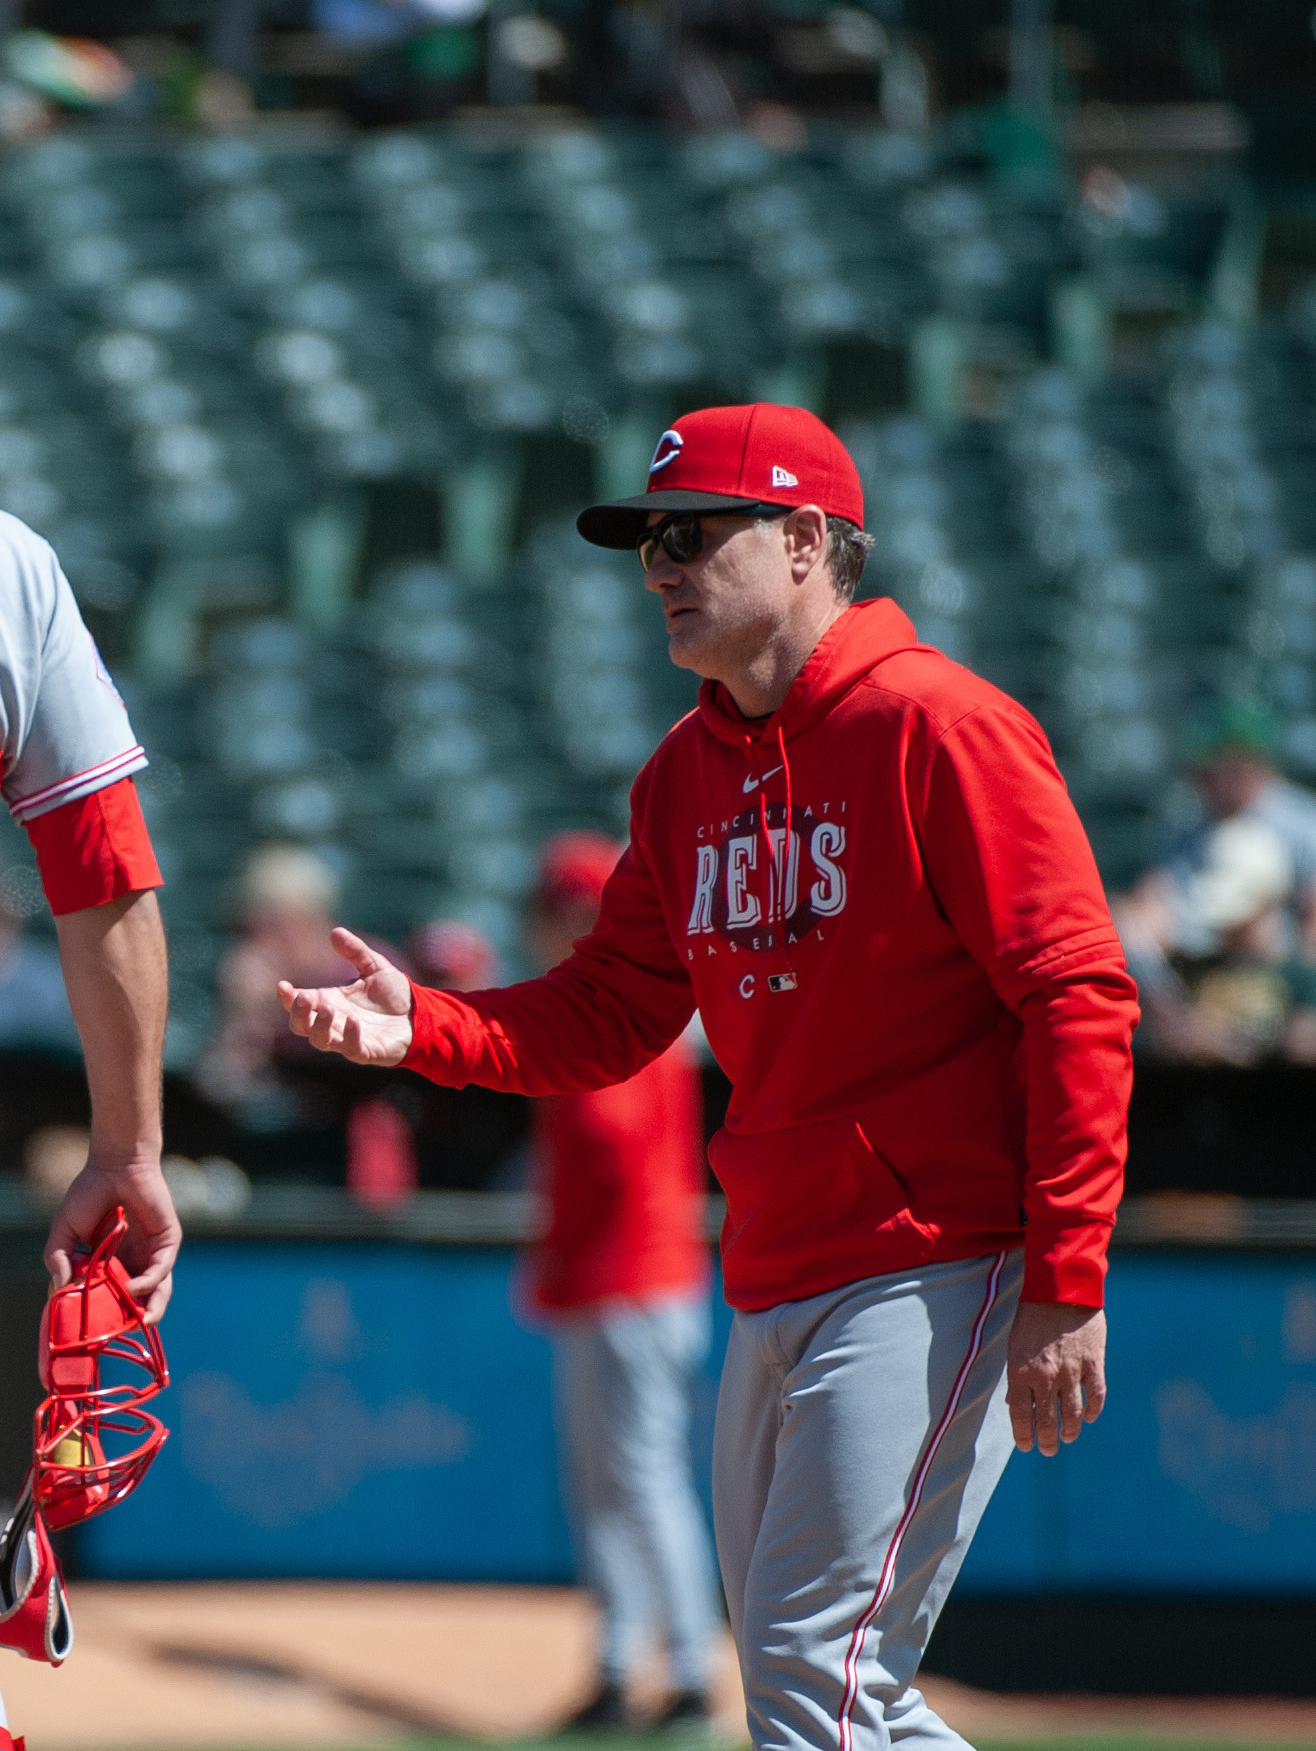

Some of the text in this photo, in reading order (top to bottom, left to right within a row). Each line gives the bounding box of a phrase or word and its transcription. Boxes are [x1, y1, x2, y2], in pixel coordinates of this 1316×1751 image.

[649, 429, 684, 474] C
[686, 821, 847, 936] REDS
[739, 974, 756, 1000] C
